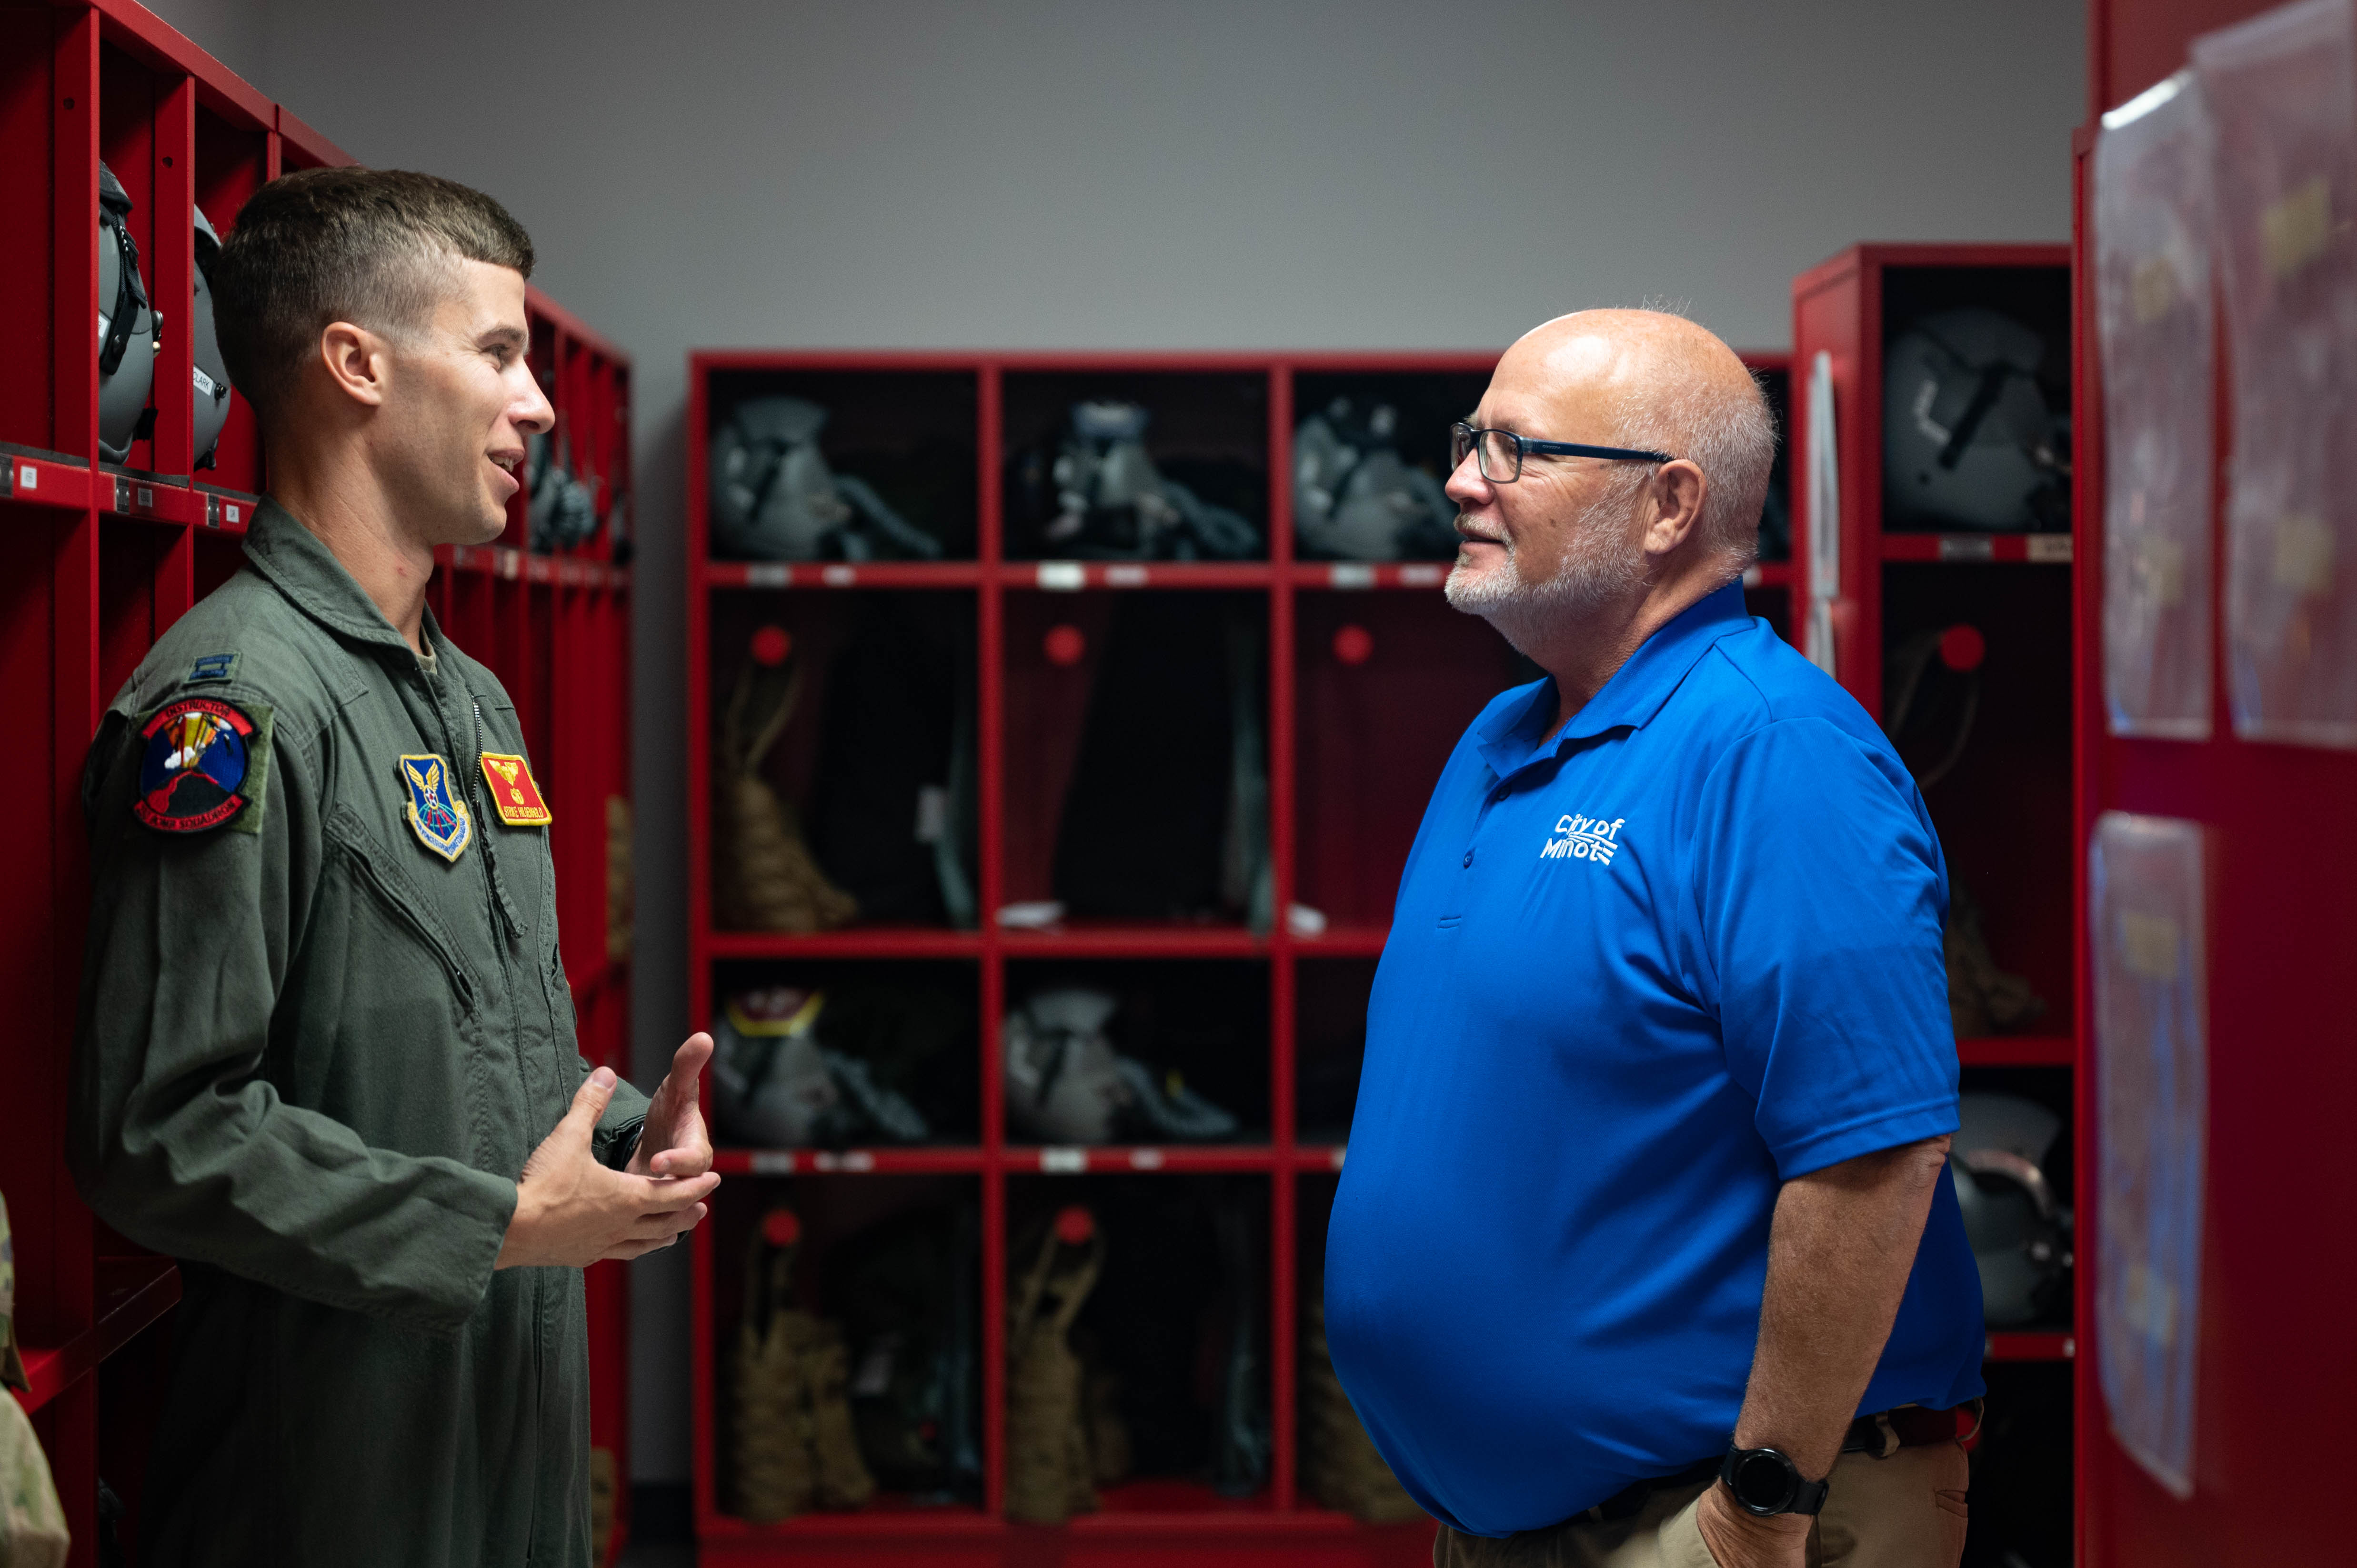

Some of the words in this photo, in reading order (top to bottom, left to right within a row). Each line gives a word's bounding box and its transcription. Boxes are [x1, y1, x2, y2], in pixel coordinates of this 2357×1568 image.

[166, 699, 230, 717] INSTRUCTOR
[1555, 813, 1596, 835] City
[1593, 819, 1625, 840] of
[1540, 838, 1603, 862] Minot
